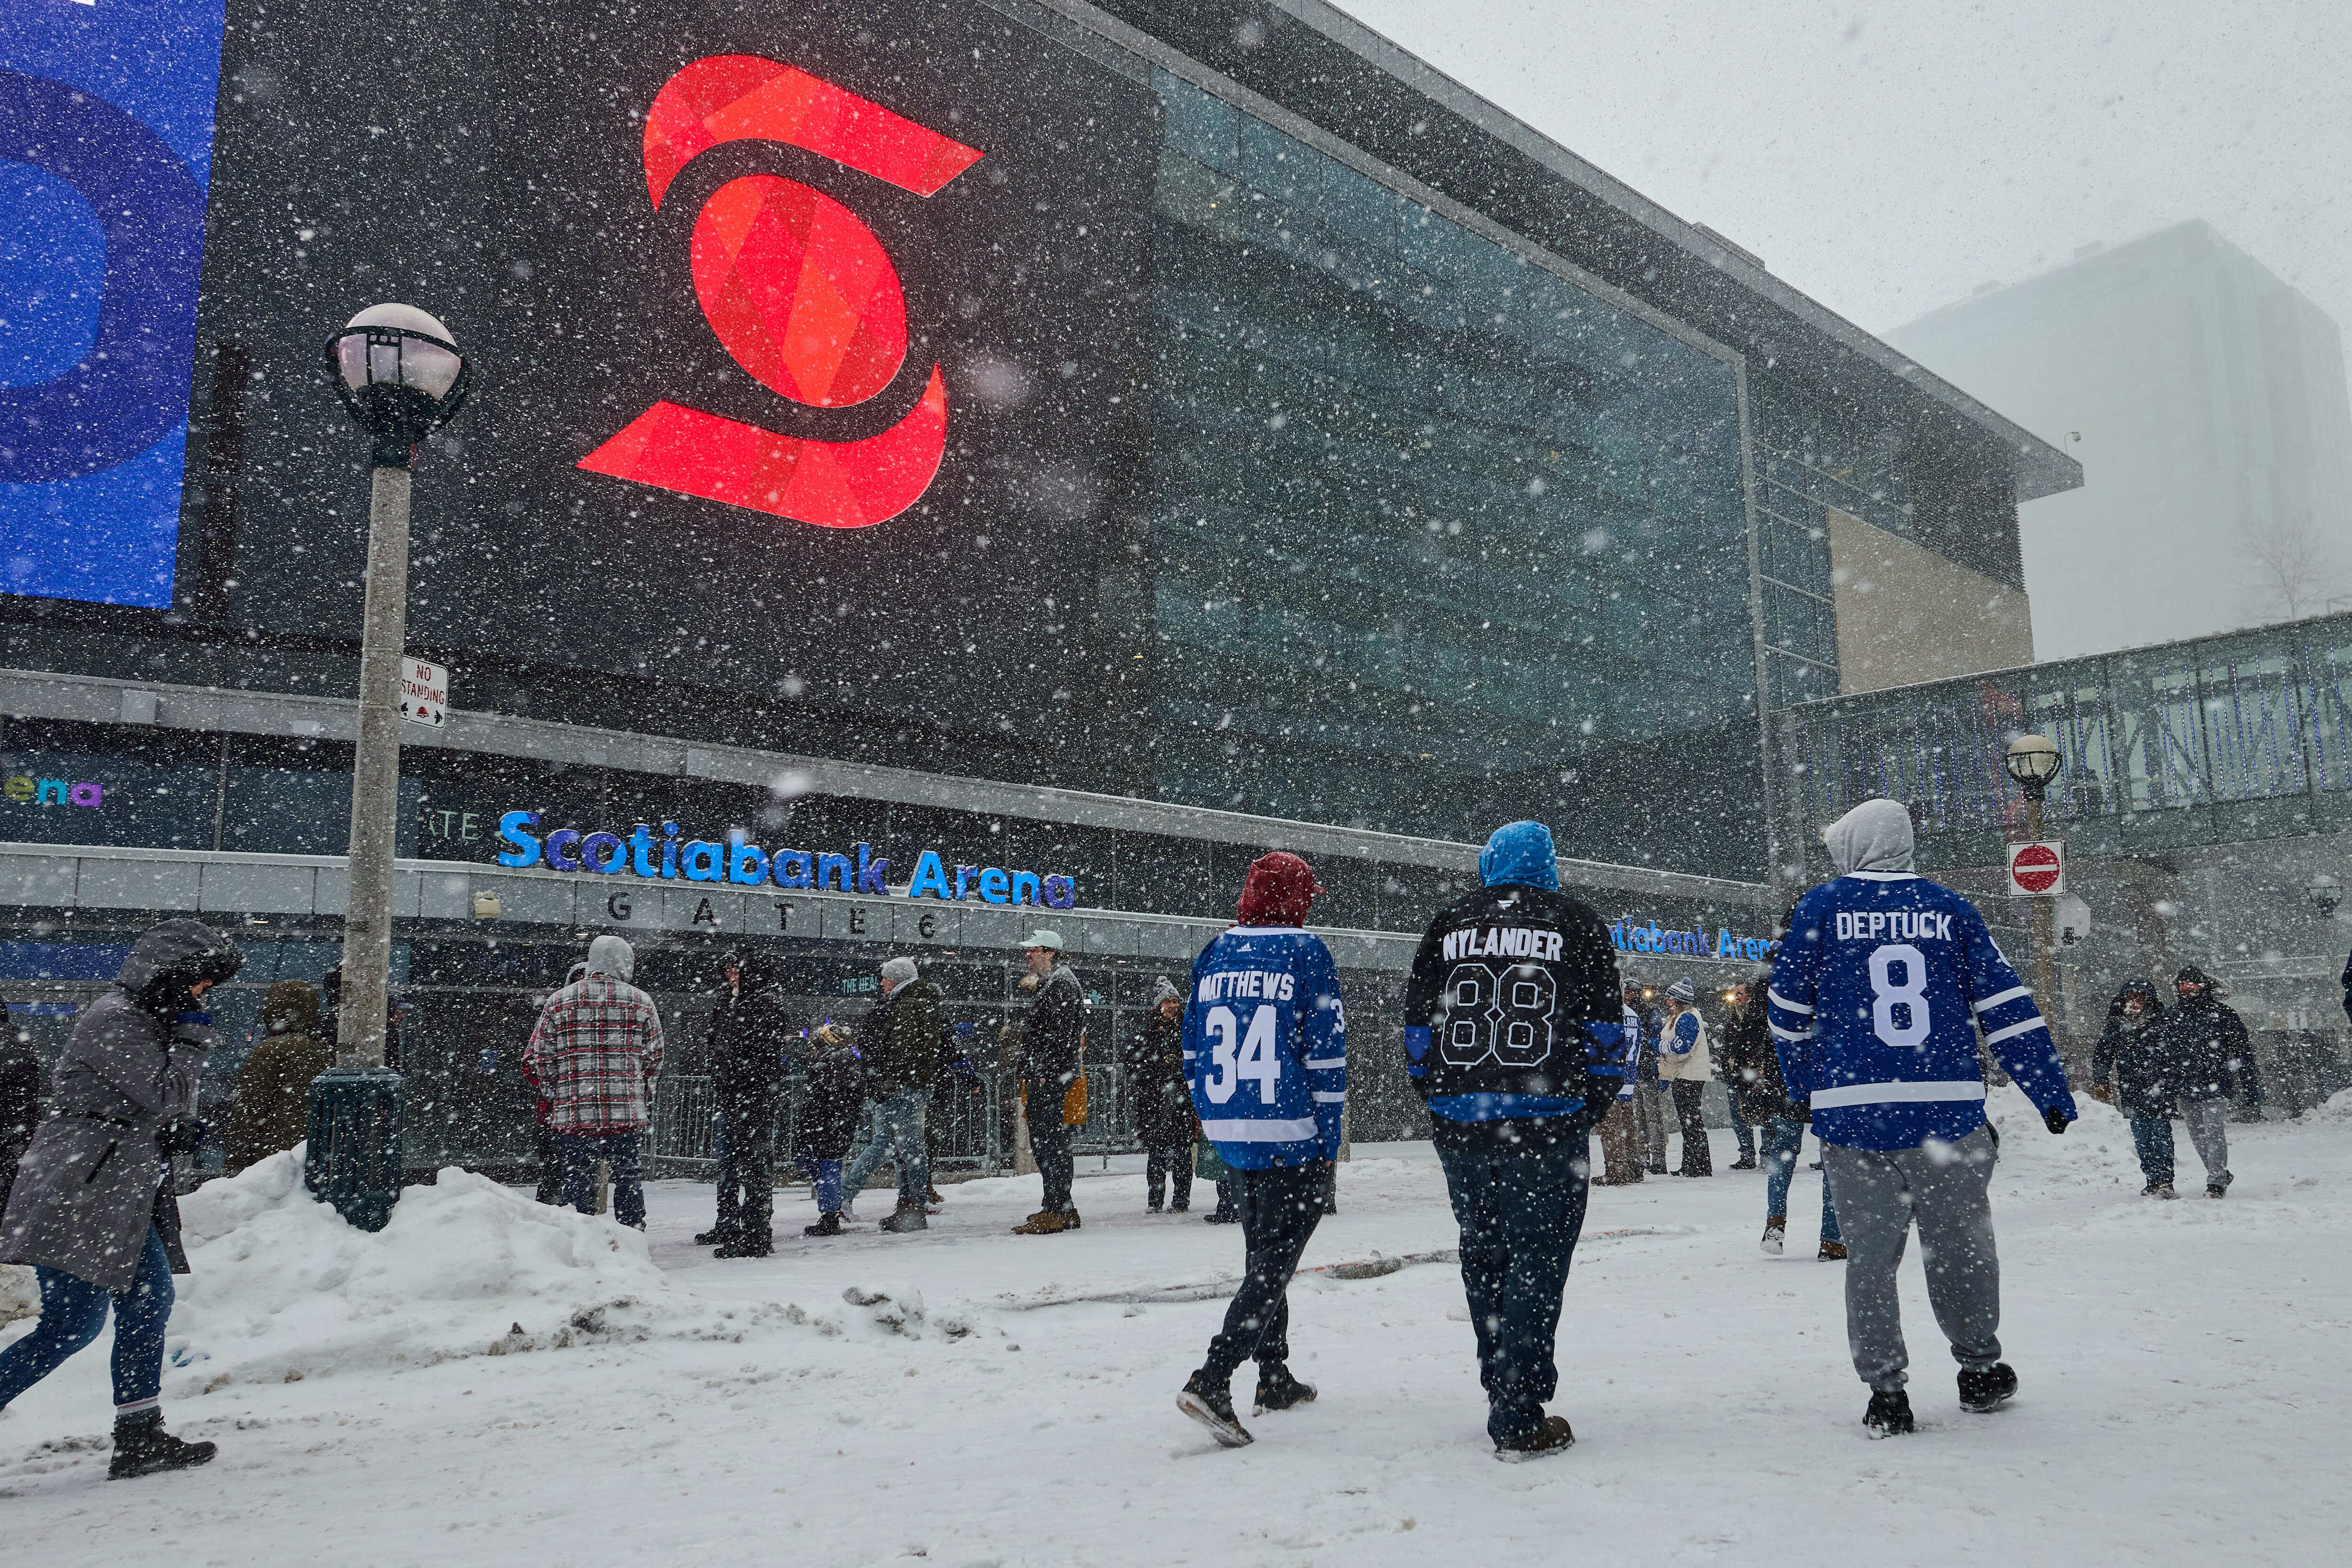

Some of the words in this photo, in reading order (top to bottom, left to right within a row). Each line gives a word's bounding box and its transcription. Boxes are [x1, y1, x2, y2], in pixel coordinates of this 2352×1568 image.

[417, 664, 431, 681] NO
[402, 679, 445, 705] STANDING
[498, 810, 891, 895] Scotiabank
[907, 851, 1074, 909] Arena
[919, 914, 936, 939] 6
[1606, 915, 1712, 956] tiabank
[1836, 911, 1952, 941] DEPTUCK
[1443, 927, 1563, 961] NYLANDER
[842, 978, 857, 994] THE
[1198, 971, 1295, 1002] MATTHEWS
[1868, 944, 1930, 1047] 8
[1330, 999, 1345, 1033] 3
[1441, 963, 1556, 1066] 88
[1205, 1005, 1281, 1104] 34
[1624, 1028, 1638, 1061] 7
